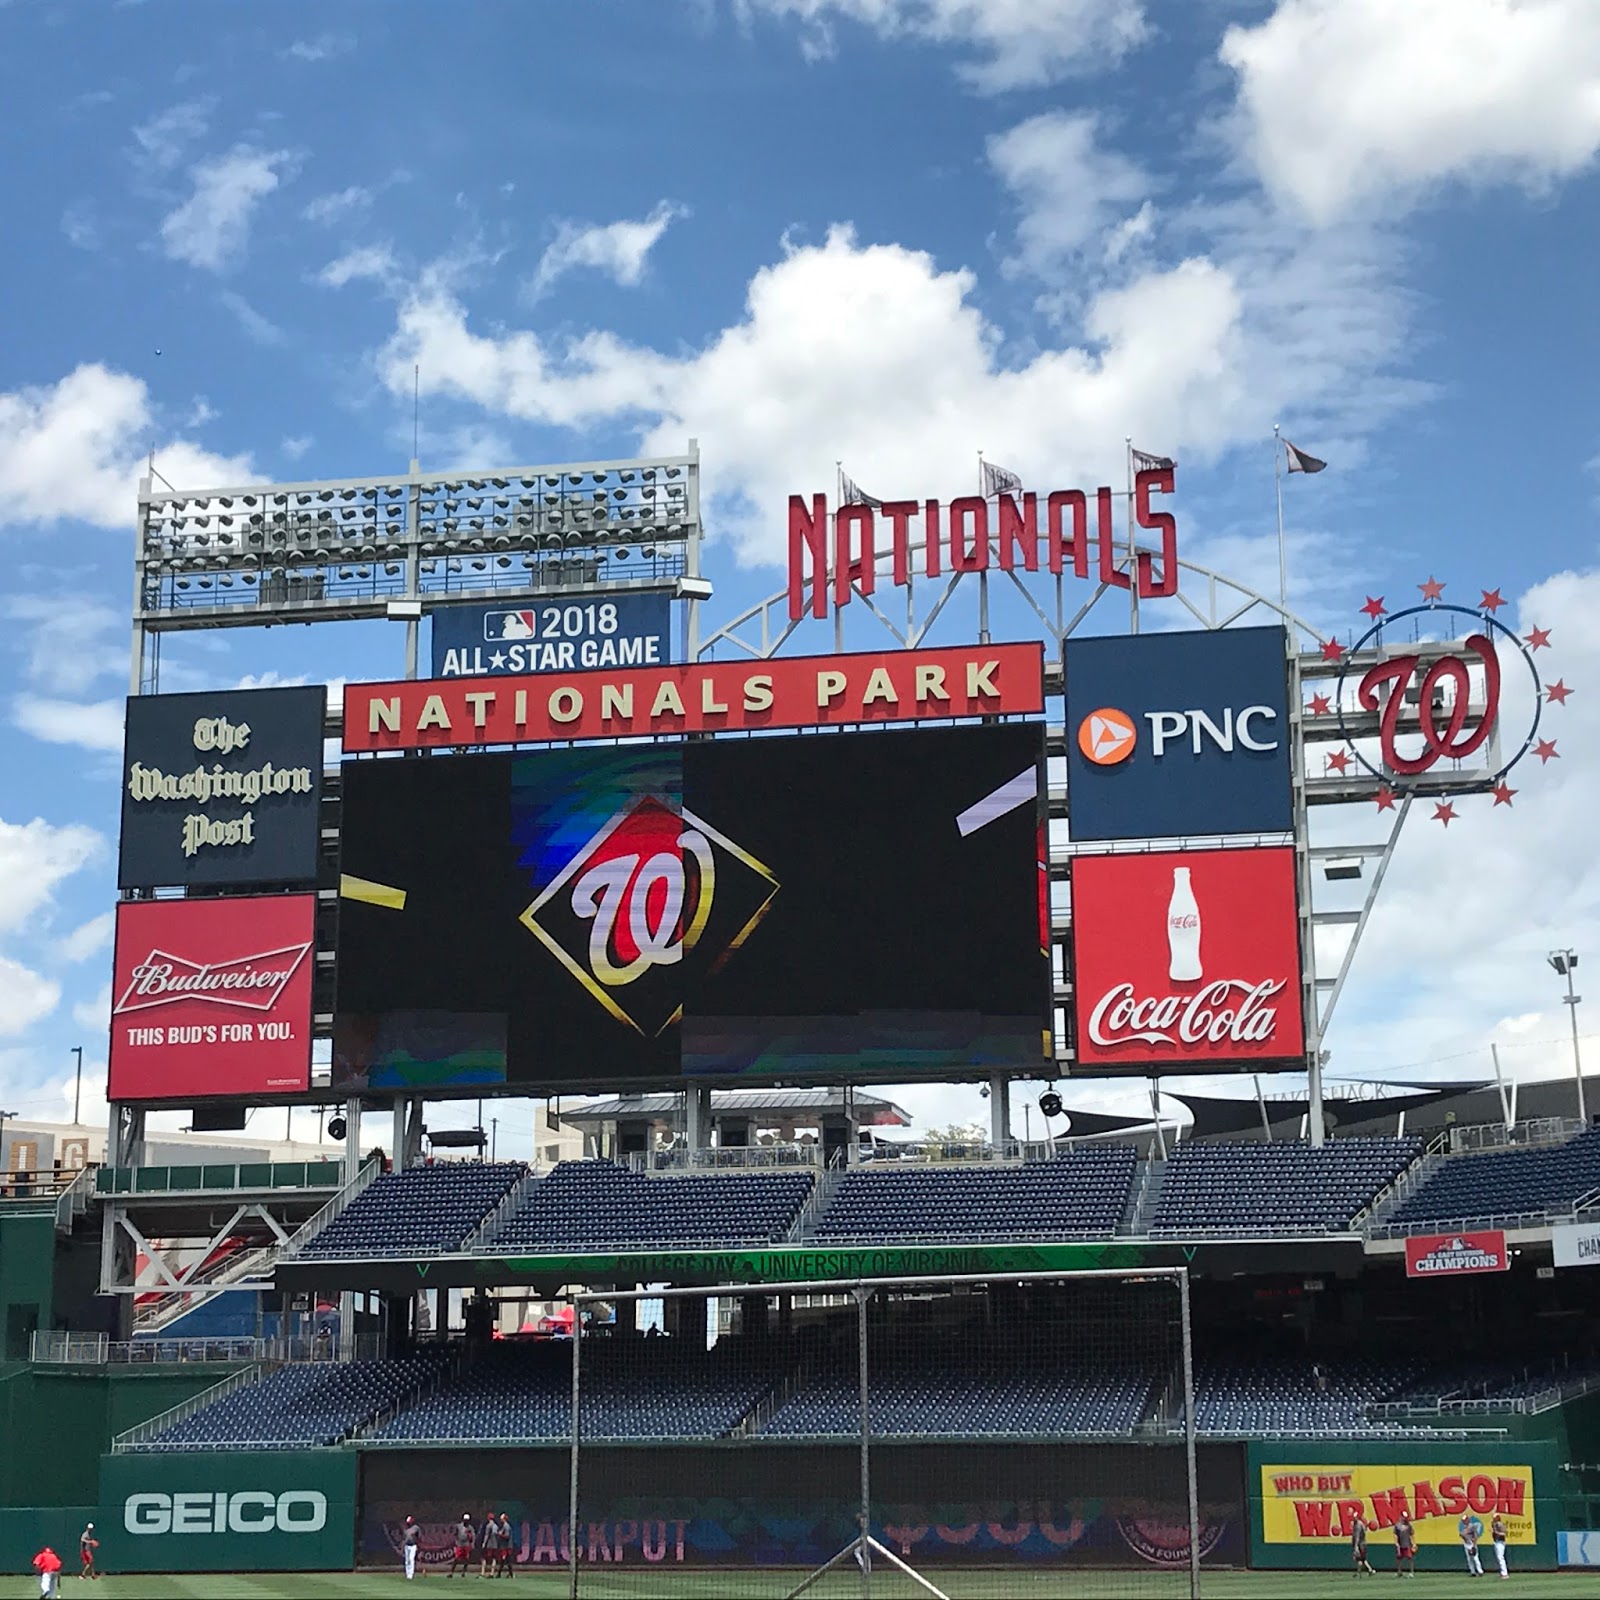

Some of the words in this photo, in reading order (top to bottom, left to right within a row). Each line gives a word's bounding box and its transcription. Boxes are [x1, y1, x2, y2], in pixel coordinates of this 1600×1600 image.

[789, 468, 1179, 621] NATIONALS
[542, 603, 618, 638] 2018
[581, 636, 661, 667] GAME
[369, 675, 774, 732] NATIONALS
[818, 660, 1002, 706] PARK
[1358, 634, 1500, 775] W
[193, 716, 251, 755] The
[1144, 705, 1278, 756] PNC
[128, 762, 313, 804] Washington
[181, 811, 255, 858] Post
[132, 963, 289, 995] Budweiser
[1088, 977, 1288, 1046] Coca-Cola
[127, 1027, 164, 1046] THIS
[168, 1025, 217, 1044] BUD'S
[221, 1023, 253, 1042] FOR
[256, 1021, 295, 1040] YOU.
[761, 1251, 866, 1277] UNIVERSITY
[872, 1252, 895, 1273] OF
[1415, 1255, 1498, 1272] CHAMPIONS
[1274, 1475, 1314, 1493] WHO
[1318, 1474, 1352, 1492] BUT
[125, 1490, 327, 1534] GEICO
